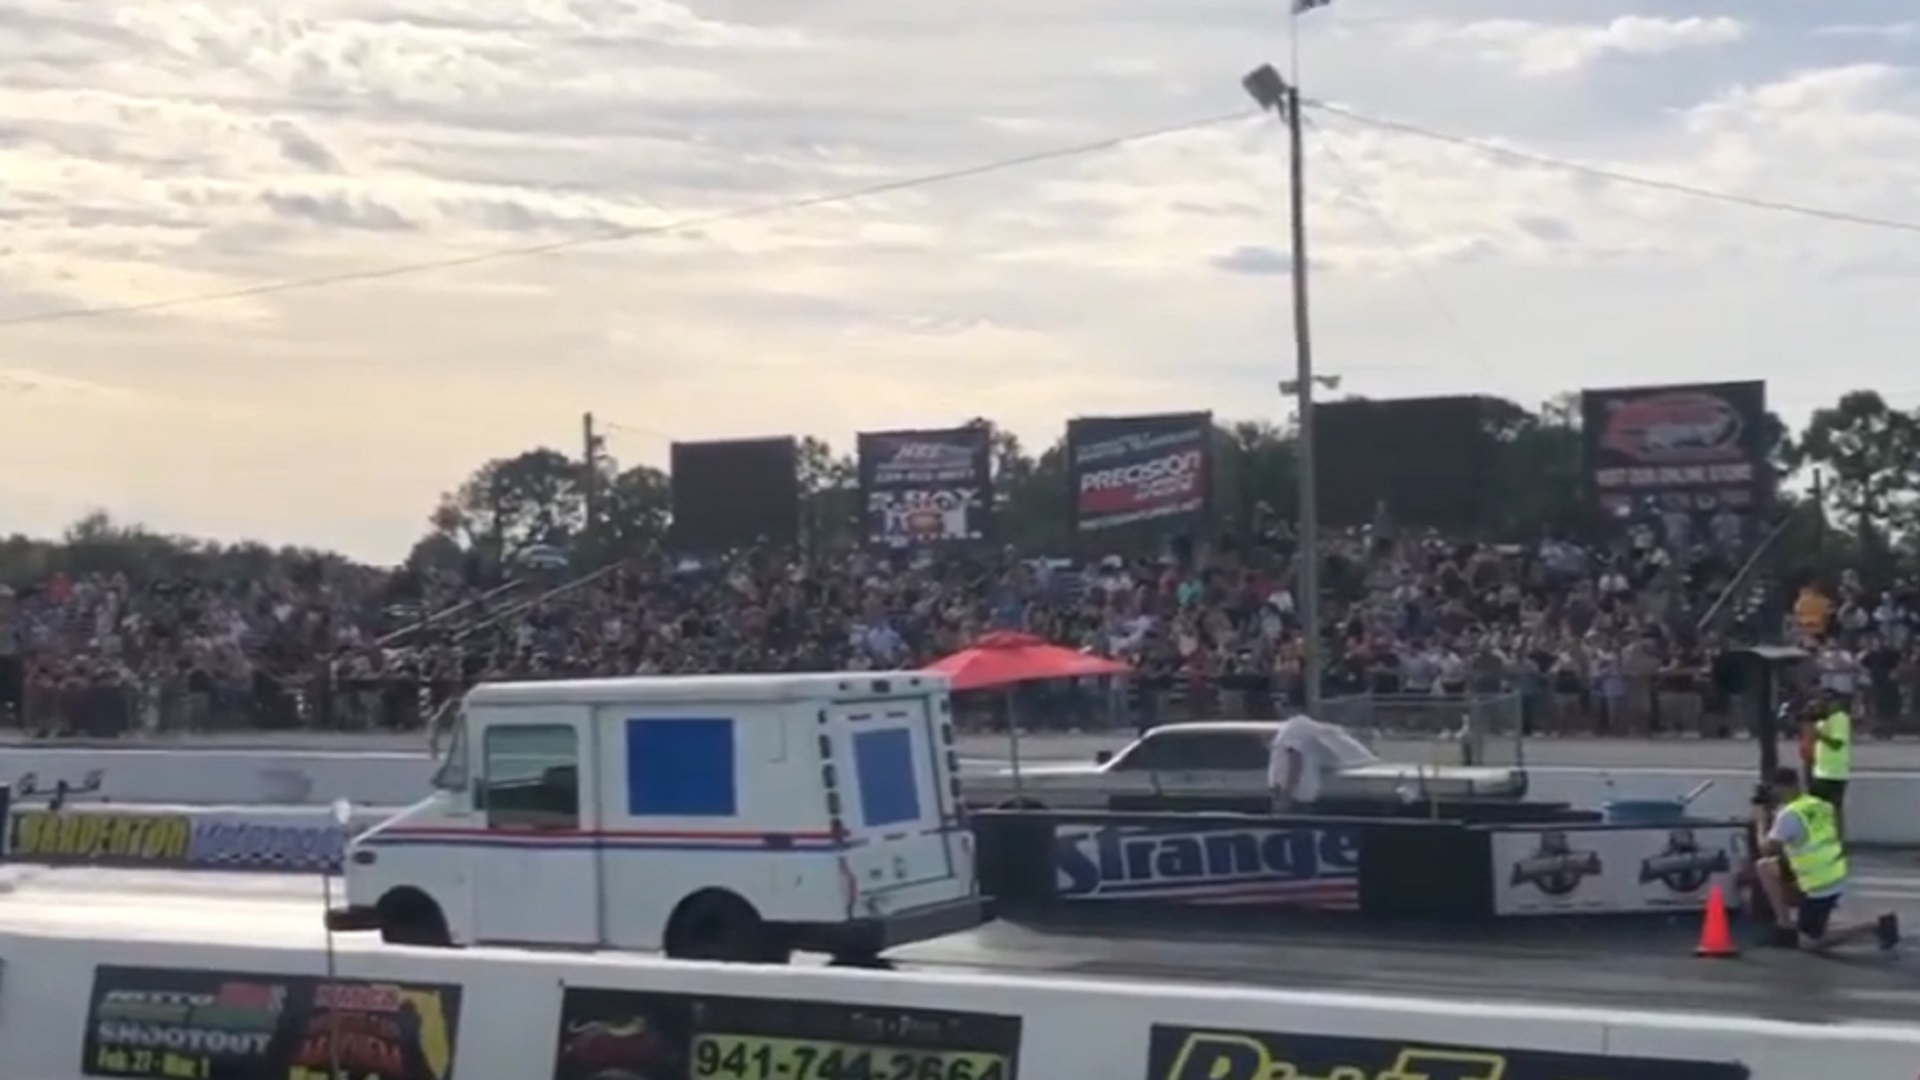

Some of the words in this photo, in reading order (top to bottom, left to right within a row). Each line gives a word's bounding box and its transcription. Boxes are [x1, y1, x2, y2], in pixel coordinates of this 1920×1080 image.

[1080, 451, 1200, 493] PRECISION
[1054, 827, 1358, 897] Strange
[98, 1021, 272, 1054] SHOOTOUT
[695, 1038, 1005, 1080] 941-744-2664
